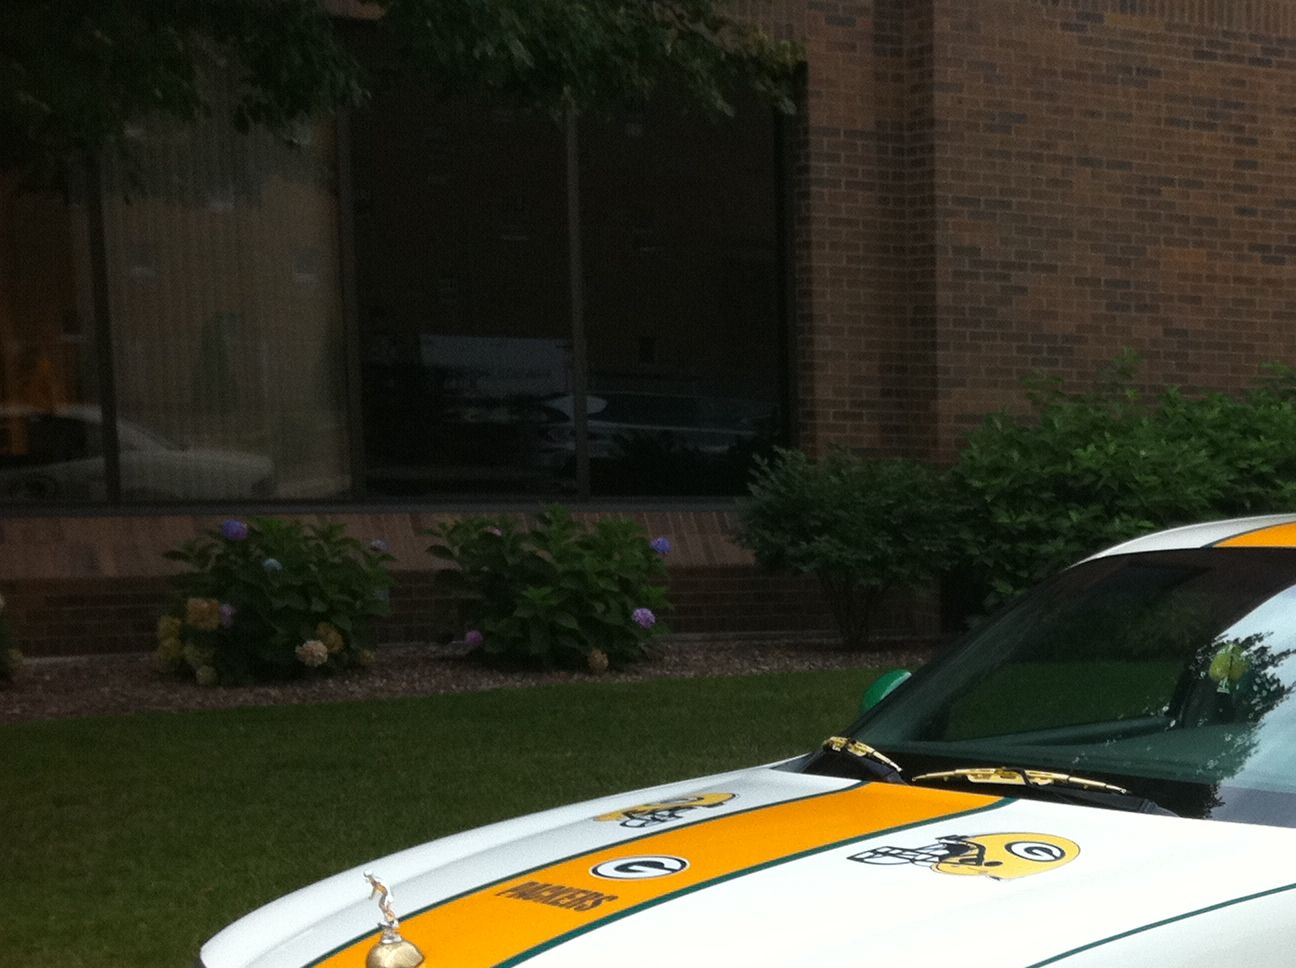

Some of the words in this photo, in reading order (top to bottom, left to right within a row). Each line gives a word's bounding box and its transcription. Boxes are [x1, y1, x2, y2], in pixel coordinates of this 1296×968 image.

[1012, 842, 1062, 861] G
[592, 856, 686, 879] G
[496, 881, 619, 912] PACKERS
